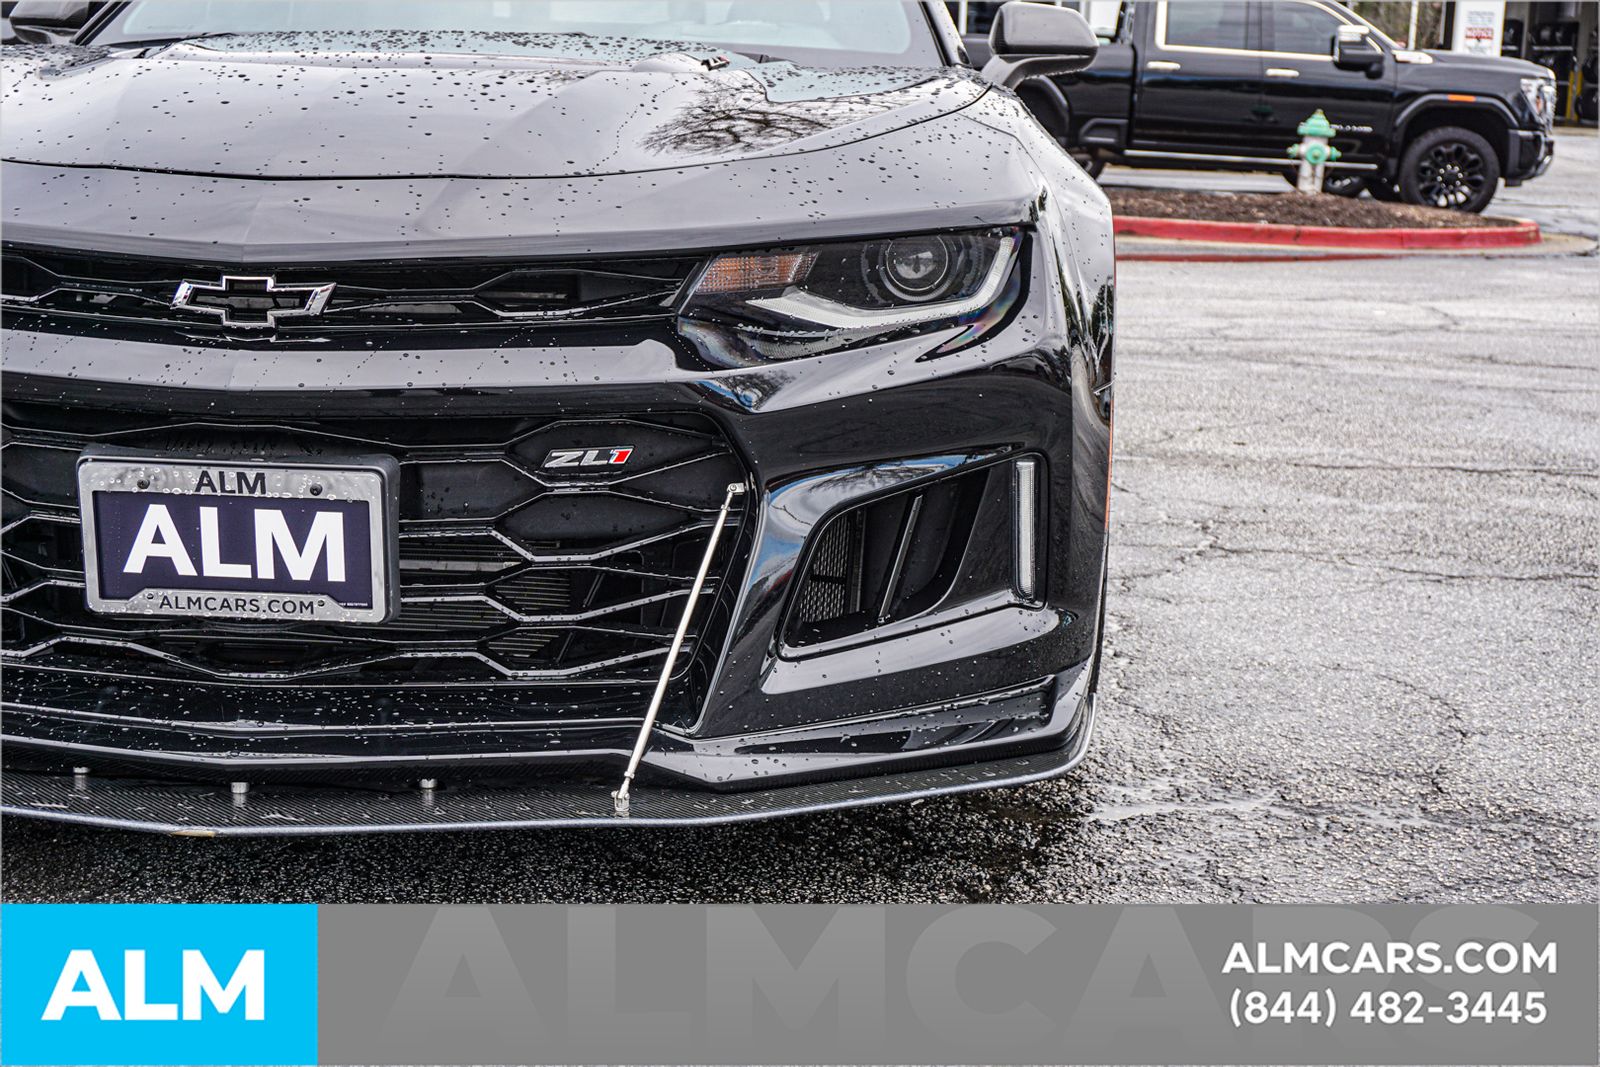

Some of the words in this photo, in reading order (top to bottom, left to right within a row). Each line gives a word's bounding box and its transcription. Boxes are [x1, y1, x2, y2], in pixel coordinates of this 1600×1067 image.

[544, 448, 633, 468] ZL1
[194, 470, 267, 495] ALM
[123, 503, 346, 582] ALM
[159, 595, 314, 615] ALMCARS.COM
